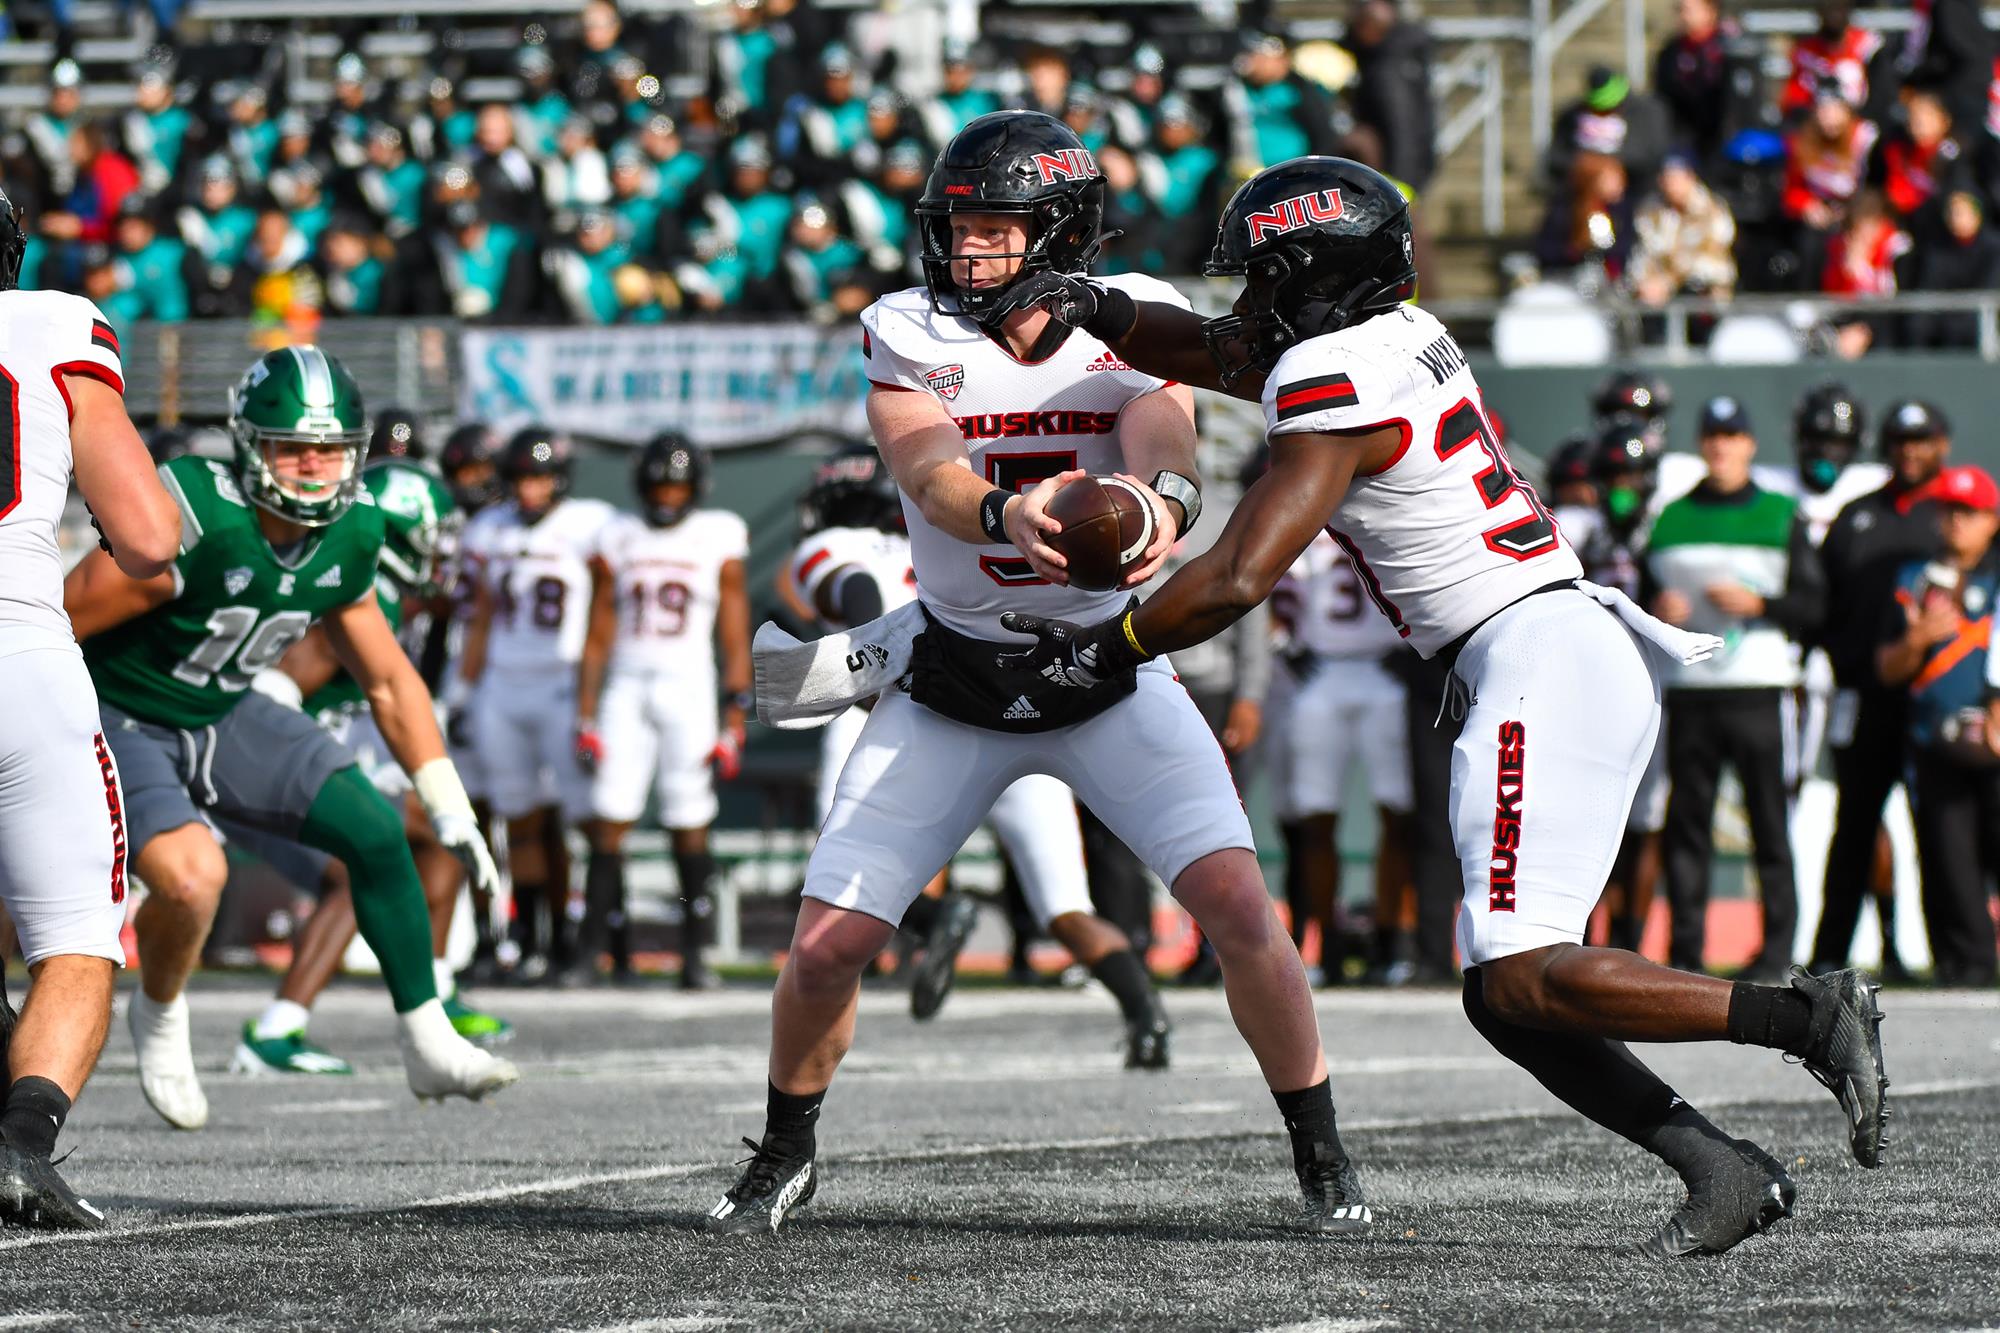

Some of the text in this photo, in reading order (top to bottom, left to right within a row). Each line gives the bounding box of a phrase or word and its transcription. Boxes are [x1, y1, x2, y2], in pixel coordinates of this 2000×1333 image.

[1030, 149, 1100, 186] NIU
[1245, 188, 1345, 247] NIU
[1086, 361, 1132, 371] adidas
[1415, 335, 1467, 385] WAYL
[929, 371, 964, 389] MAC
[953, 411, 1118, 439] HUSKIES
[846, 649, 873, 673] 5
[864, 643, 887, 669] adidas
[1003, 710, 1041, 719] adidas
[93, 730, 126, 904] HUSKIES
[1489, 720, 1526, 912] HUSKIES
